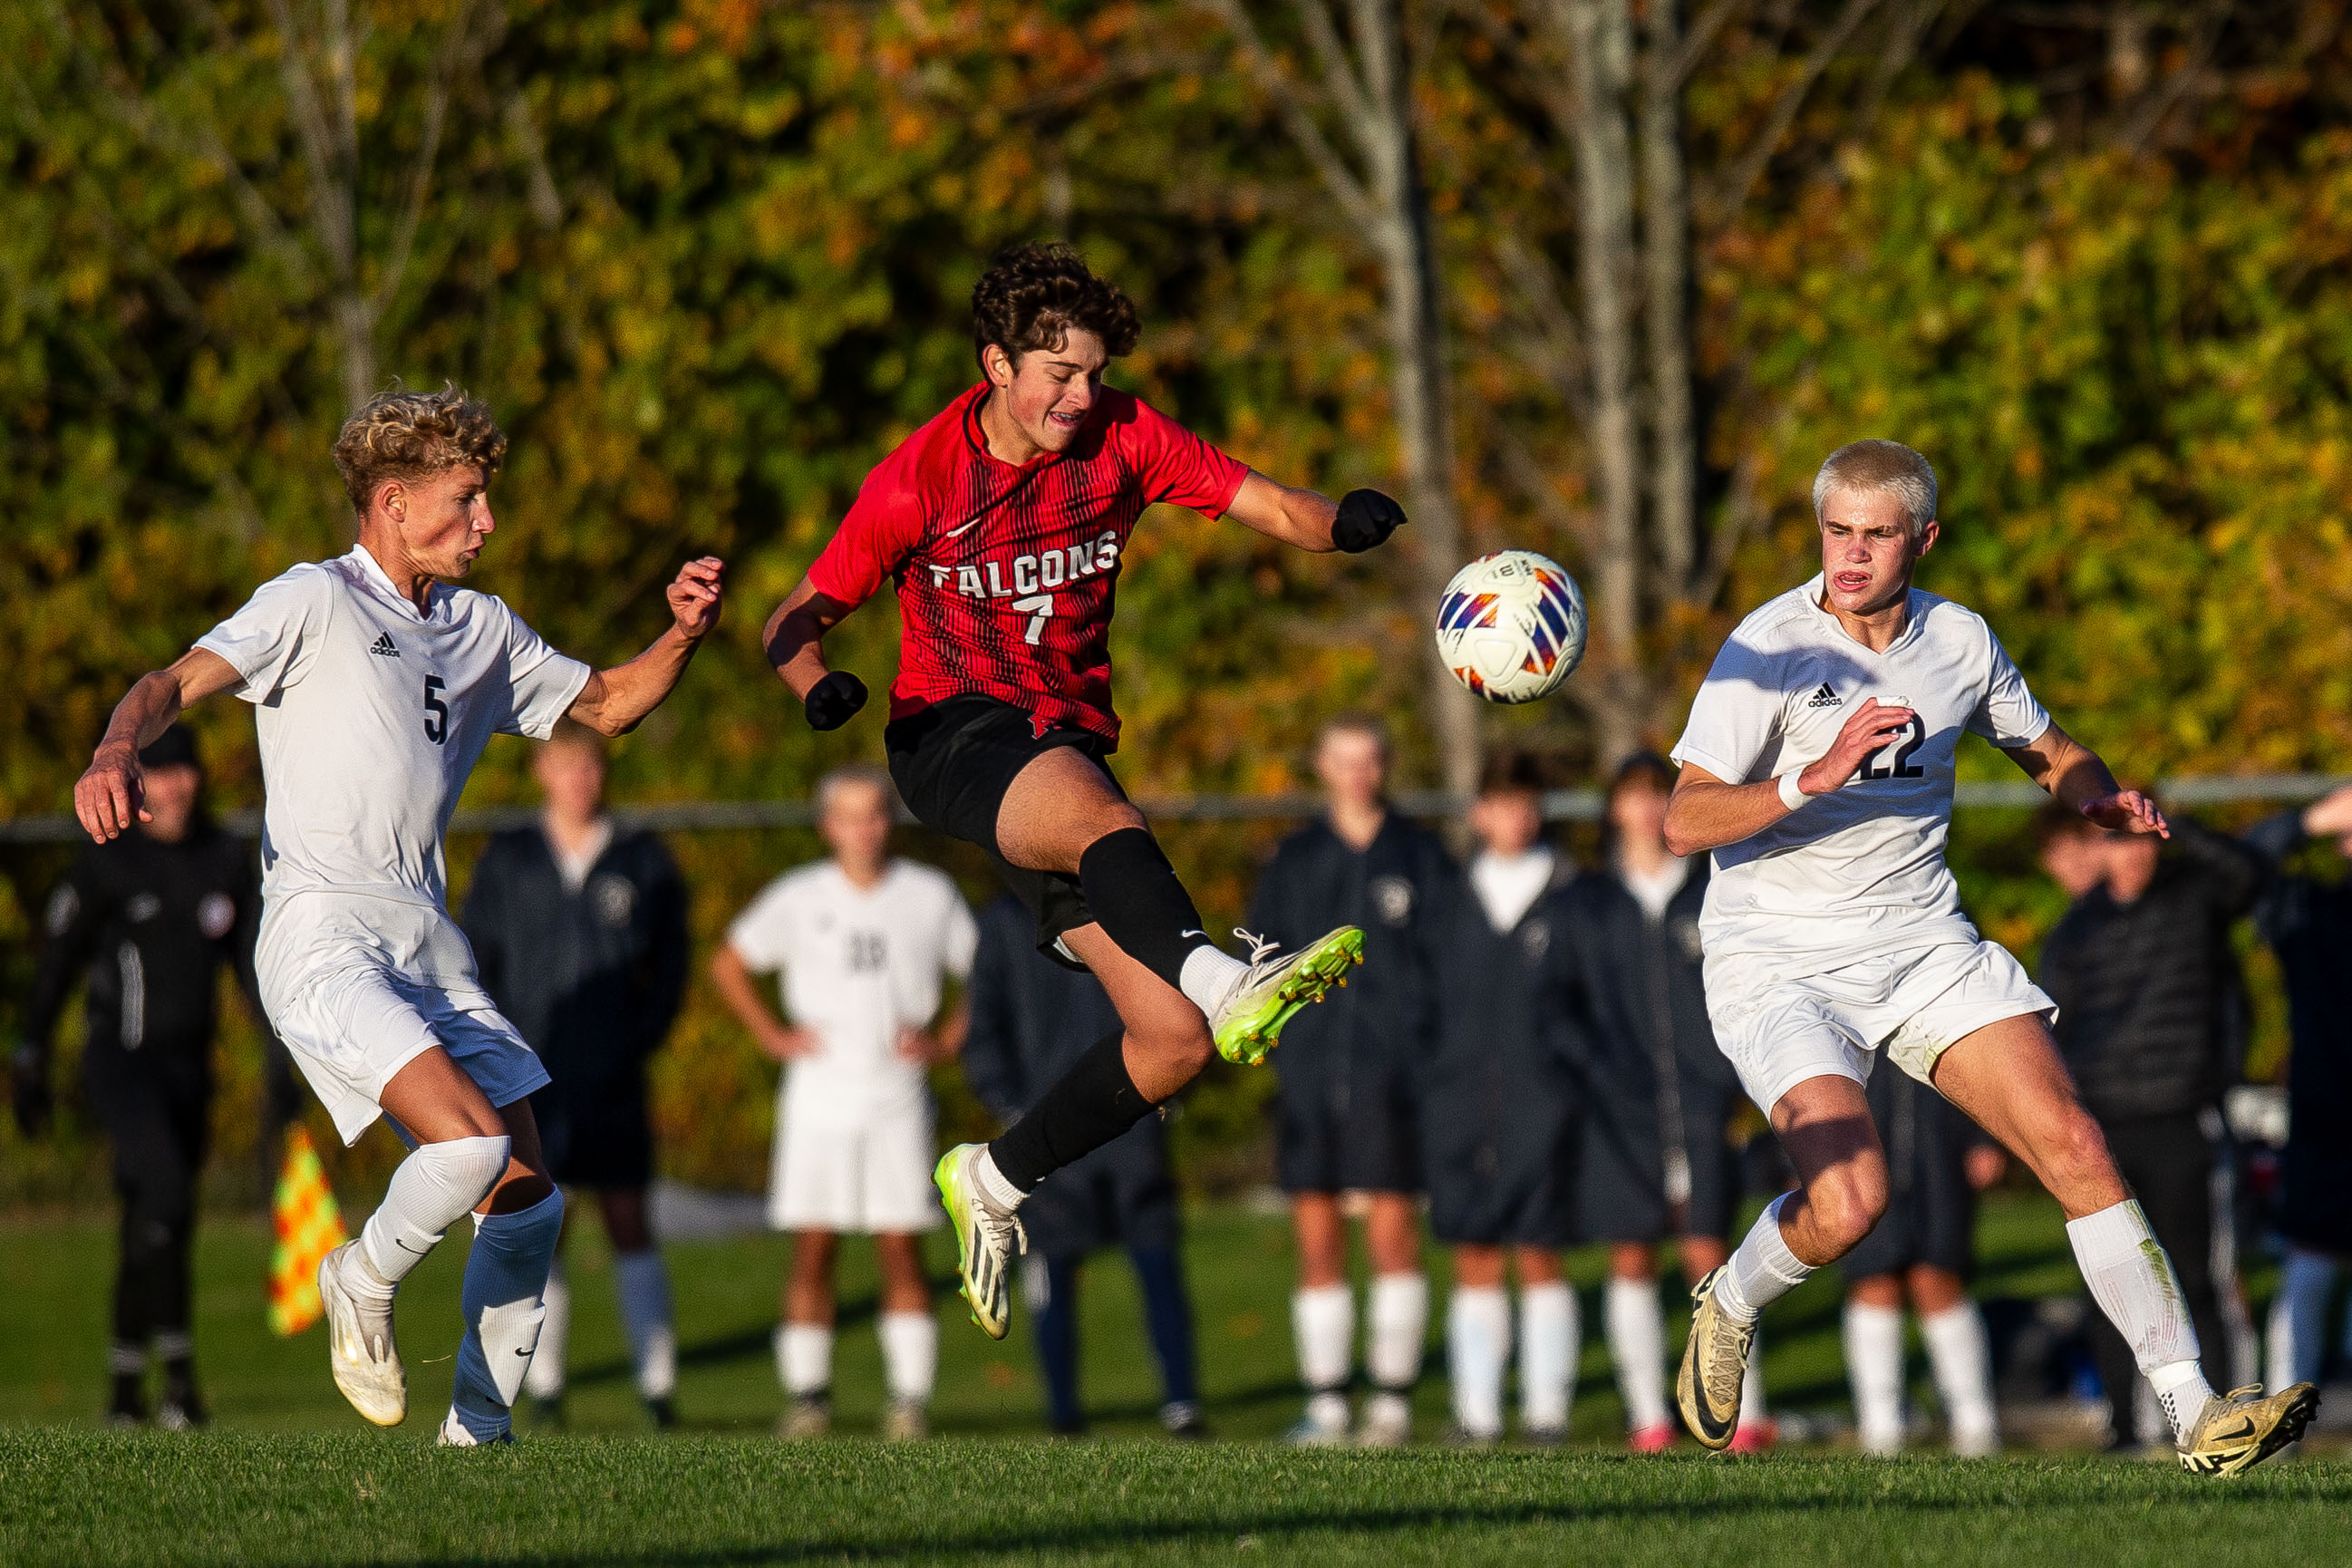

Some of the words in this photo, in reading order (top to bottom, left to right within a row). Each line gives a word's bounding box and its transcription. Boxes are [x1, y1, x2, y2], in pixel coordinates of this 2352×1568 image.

[929, 530, 1118, 598] FALCONS
[1012, 594, 1053, 645] 7
[424, 674, 449, 745] 5
[1808, 697, 1842, 708] adidas
